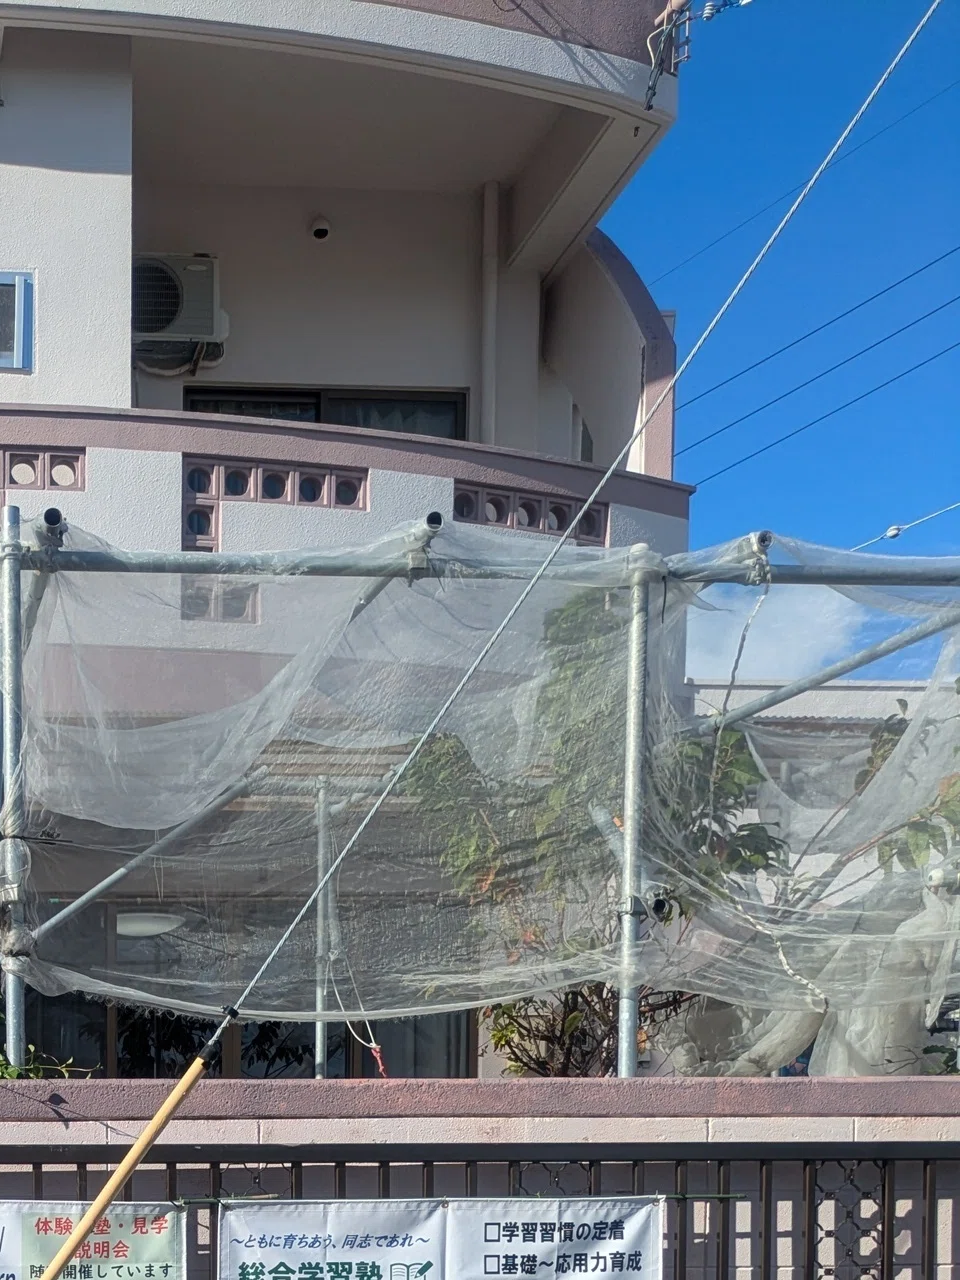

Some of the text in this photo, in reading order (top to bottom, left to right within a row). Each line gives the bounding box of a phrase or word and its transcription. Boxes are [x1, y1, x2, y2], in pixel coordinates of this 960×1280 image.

[35, 1216, 169, 1235] 体験塾・見学
[30, 1263, 173, 1279] 随開催しています
